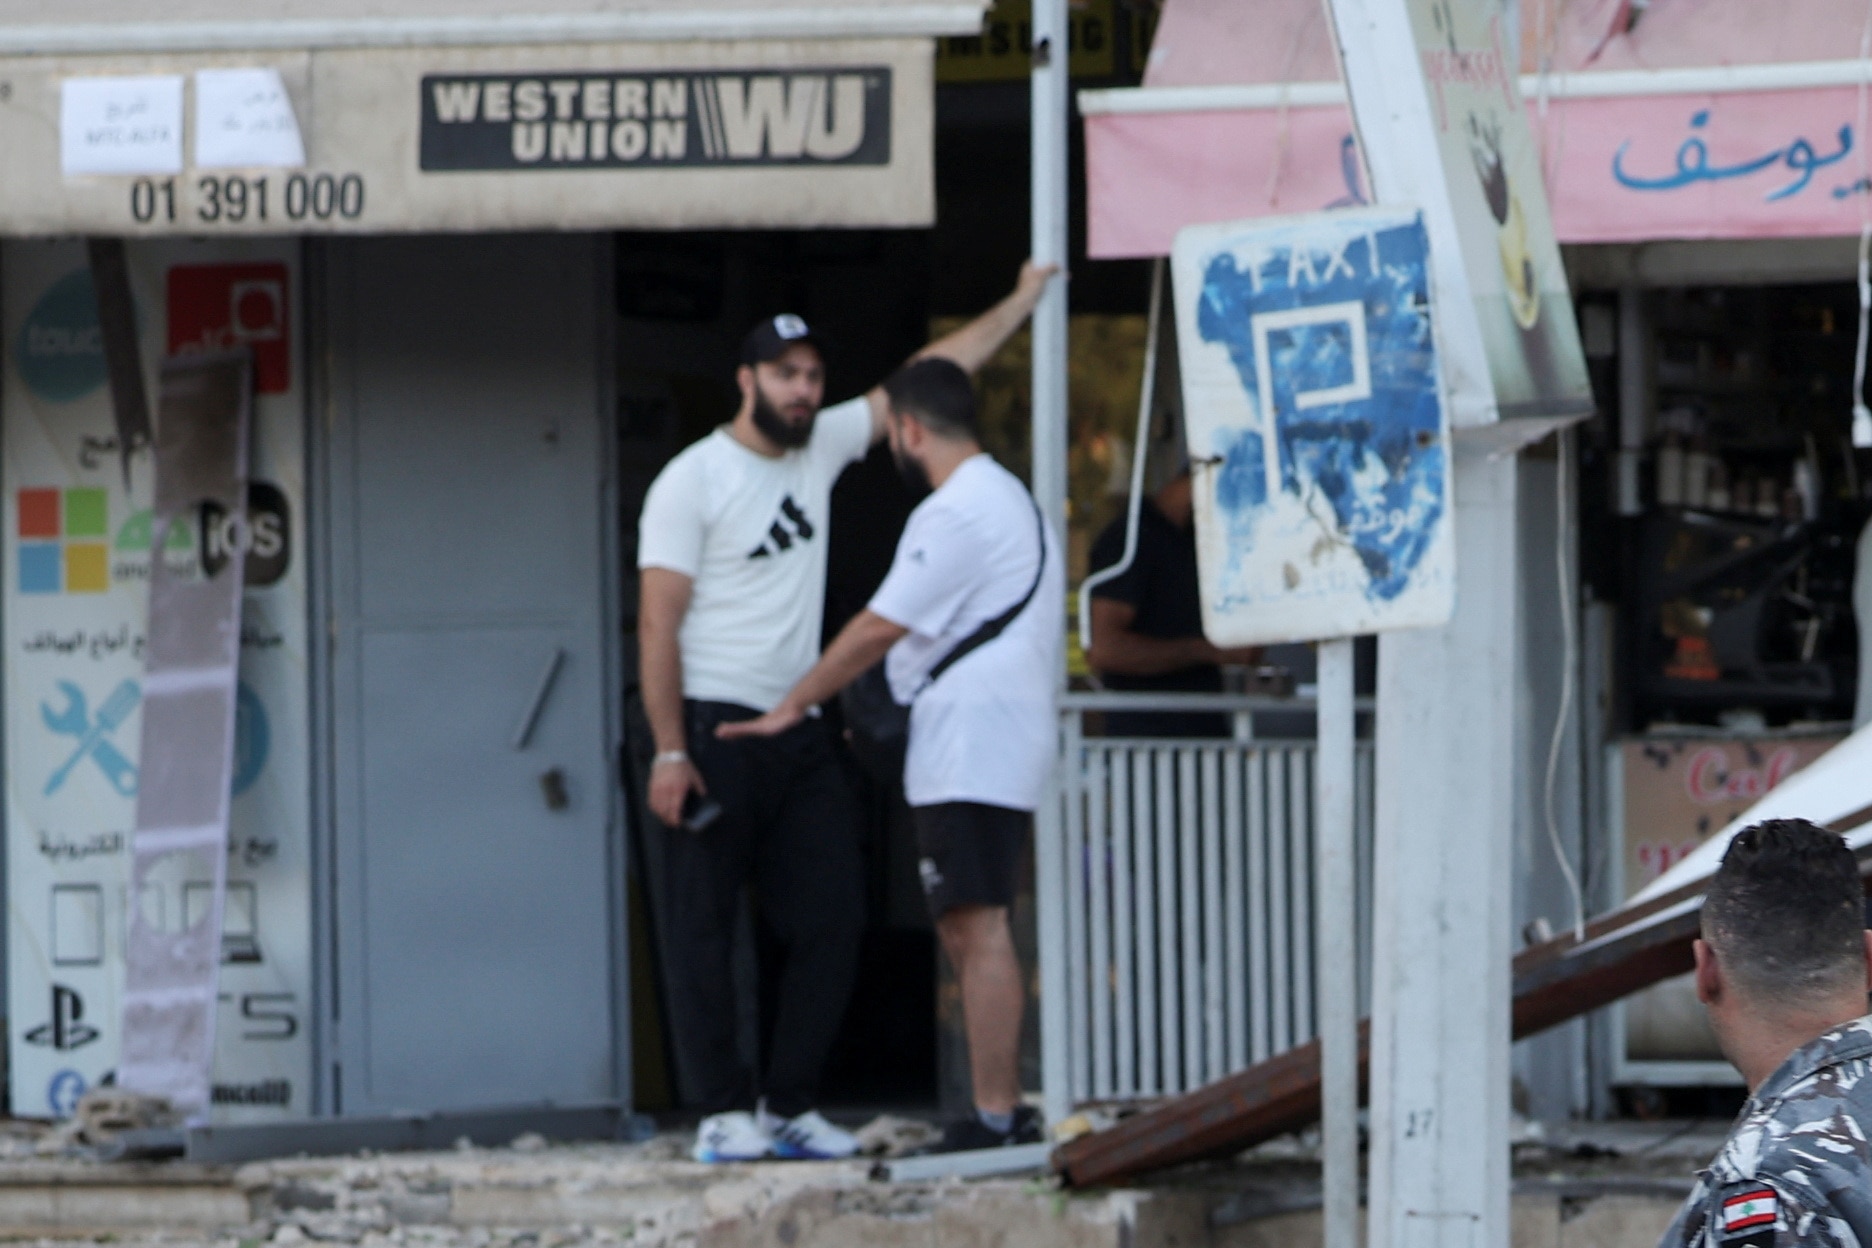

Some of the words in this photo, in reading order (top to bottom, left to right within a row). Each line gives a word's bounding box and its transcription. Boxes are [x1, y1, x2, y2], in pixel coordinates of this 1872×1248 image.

[432, 77, 688, 123] WESTERN
[714, 73, 866, 160] WU
[510, 119, 688, 162] UNION
[1612, 109, 1868, 202] يوسف
[130, 175, 178, 223] 01
[198, 173, 269, 223] 391
[284, 171, 365, 221] 000
[1250, 299, 1373, 503] P
